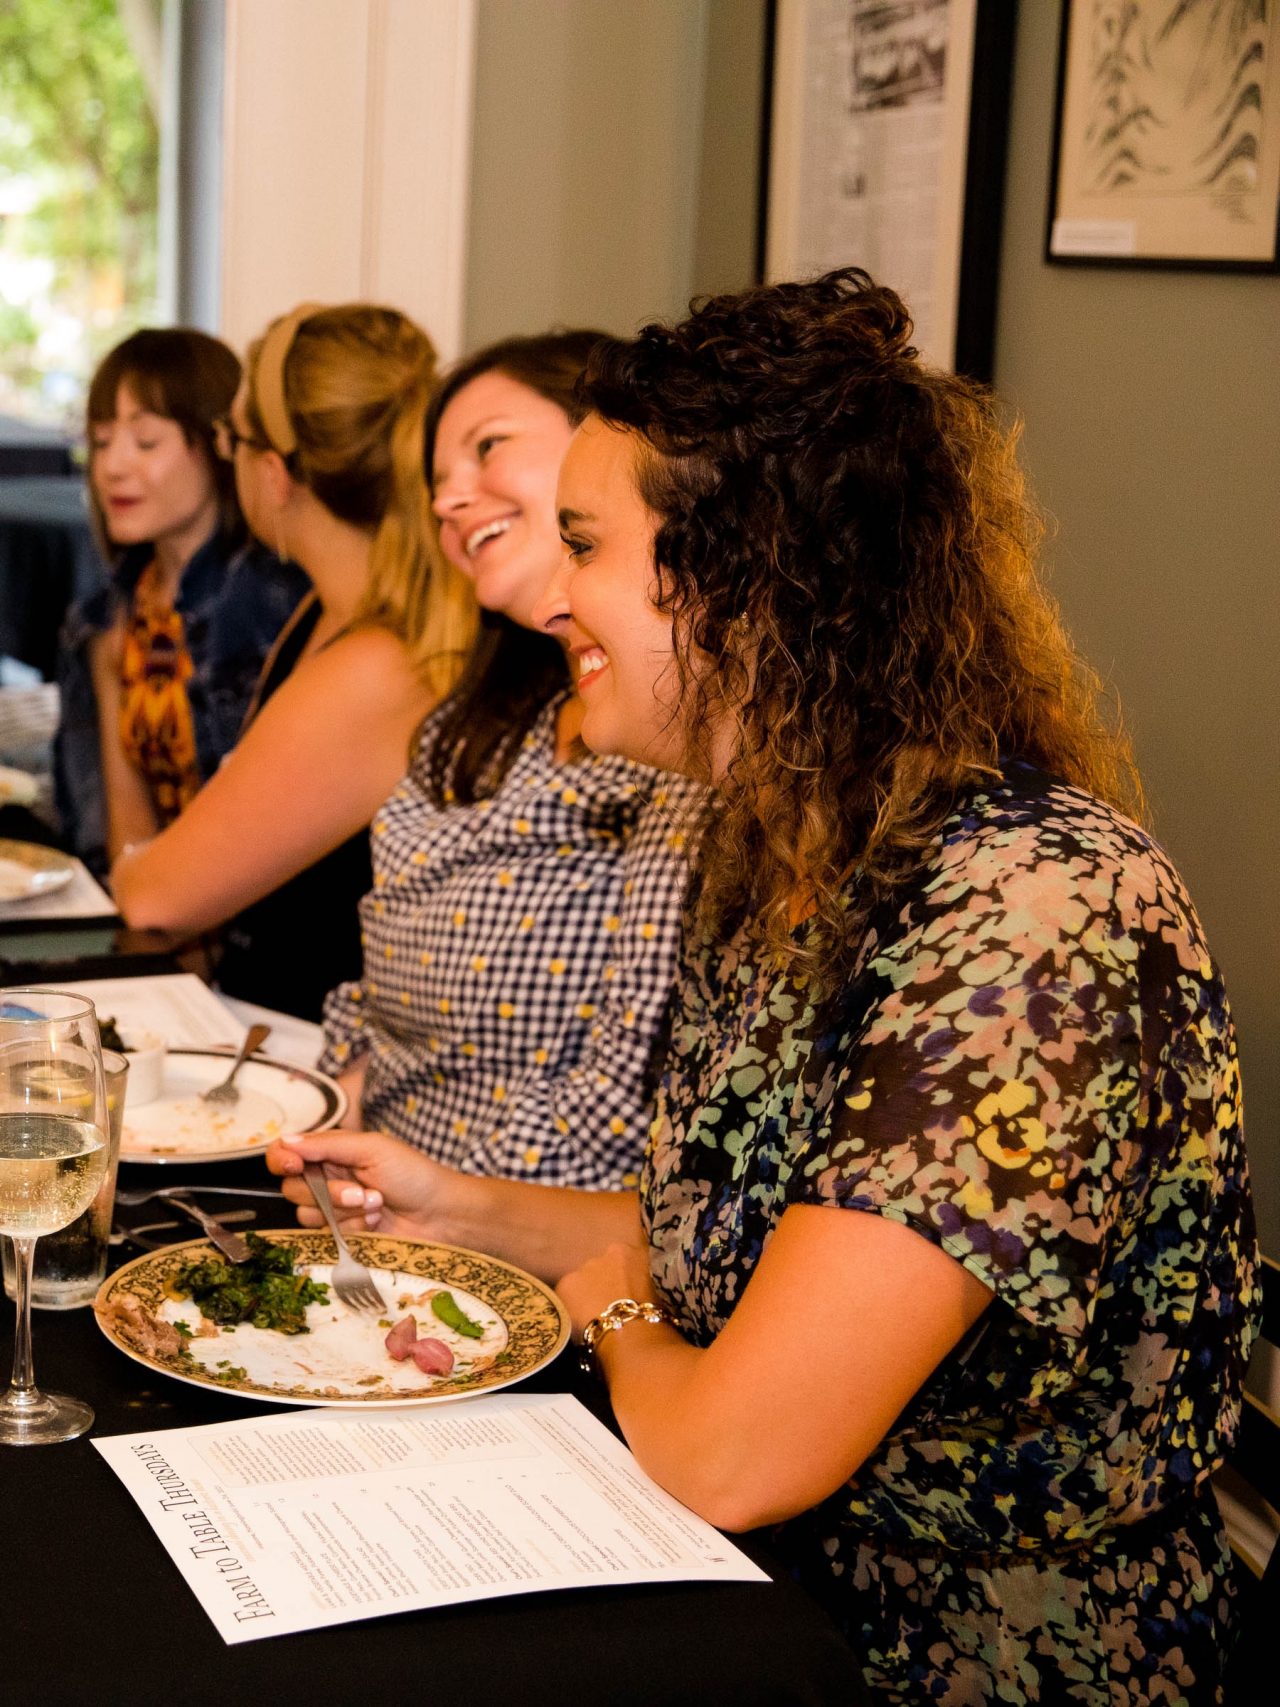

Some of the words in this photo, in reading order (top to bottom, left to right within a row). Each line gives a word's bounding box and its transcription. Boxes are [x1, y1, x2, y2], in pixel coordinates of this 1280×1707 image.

[131, 1443, 199, 1512] THURSDAYS
[182, 1510, 231, 1559] TABLE
[215, 1557, 243, 1573] to
[226, 1575, 276, 1623] FARM
